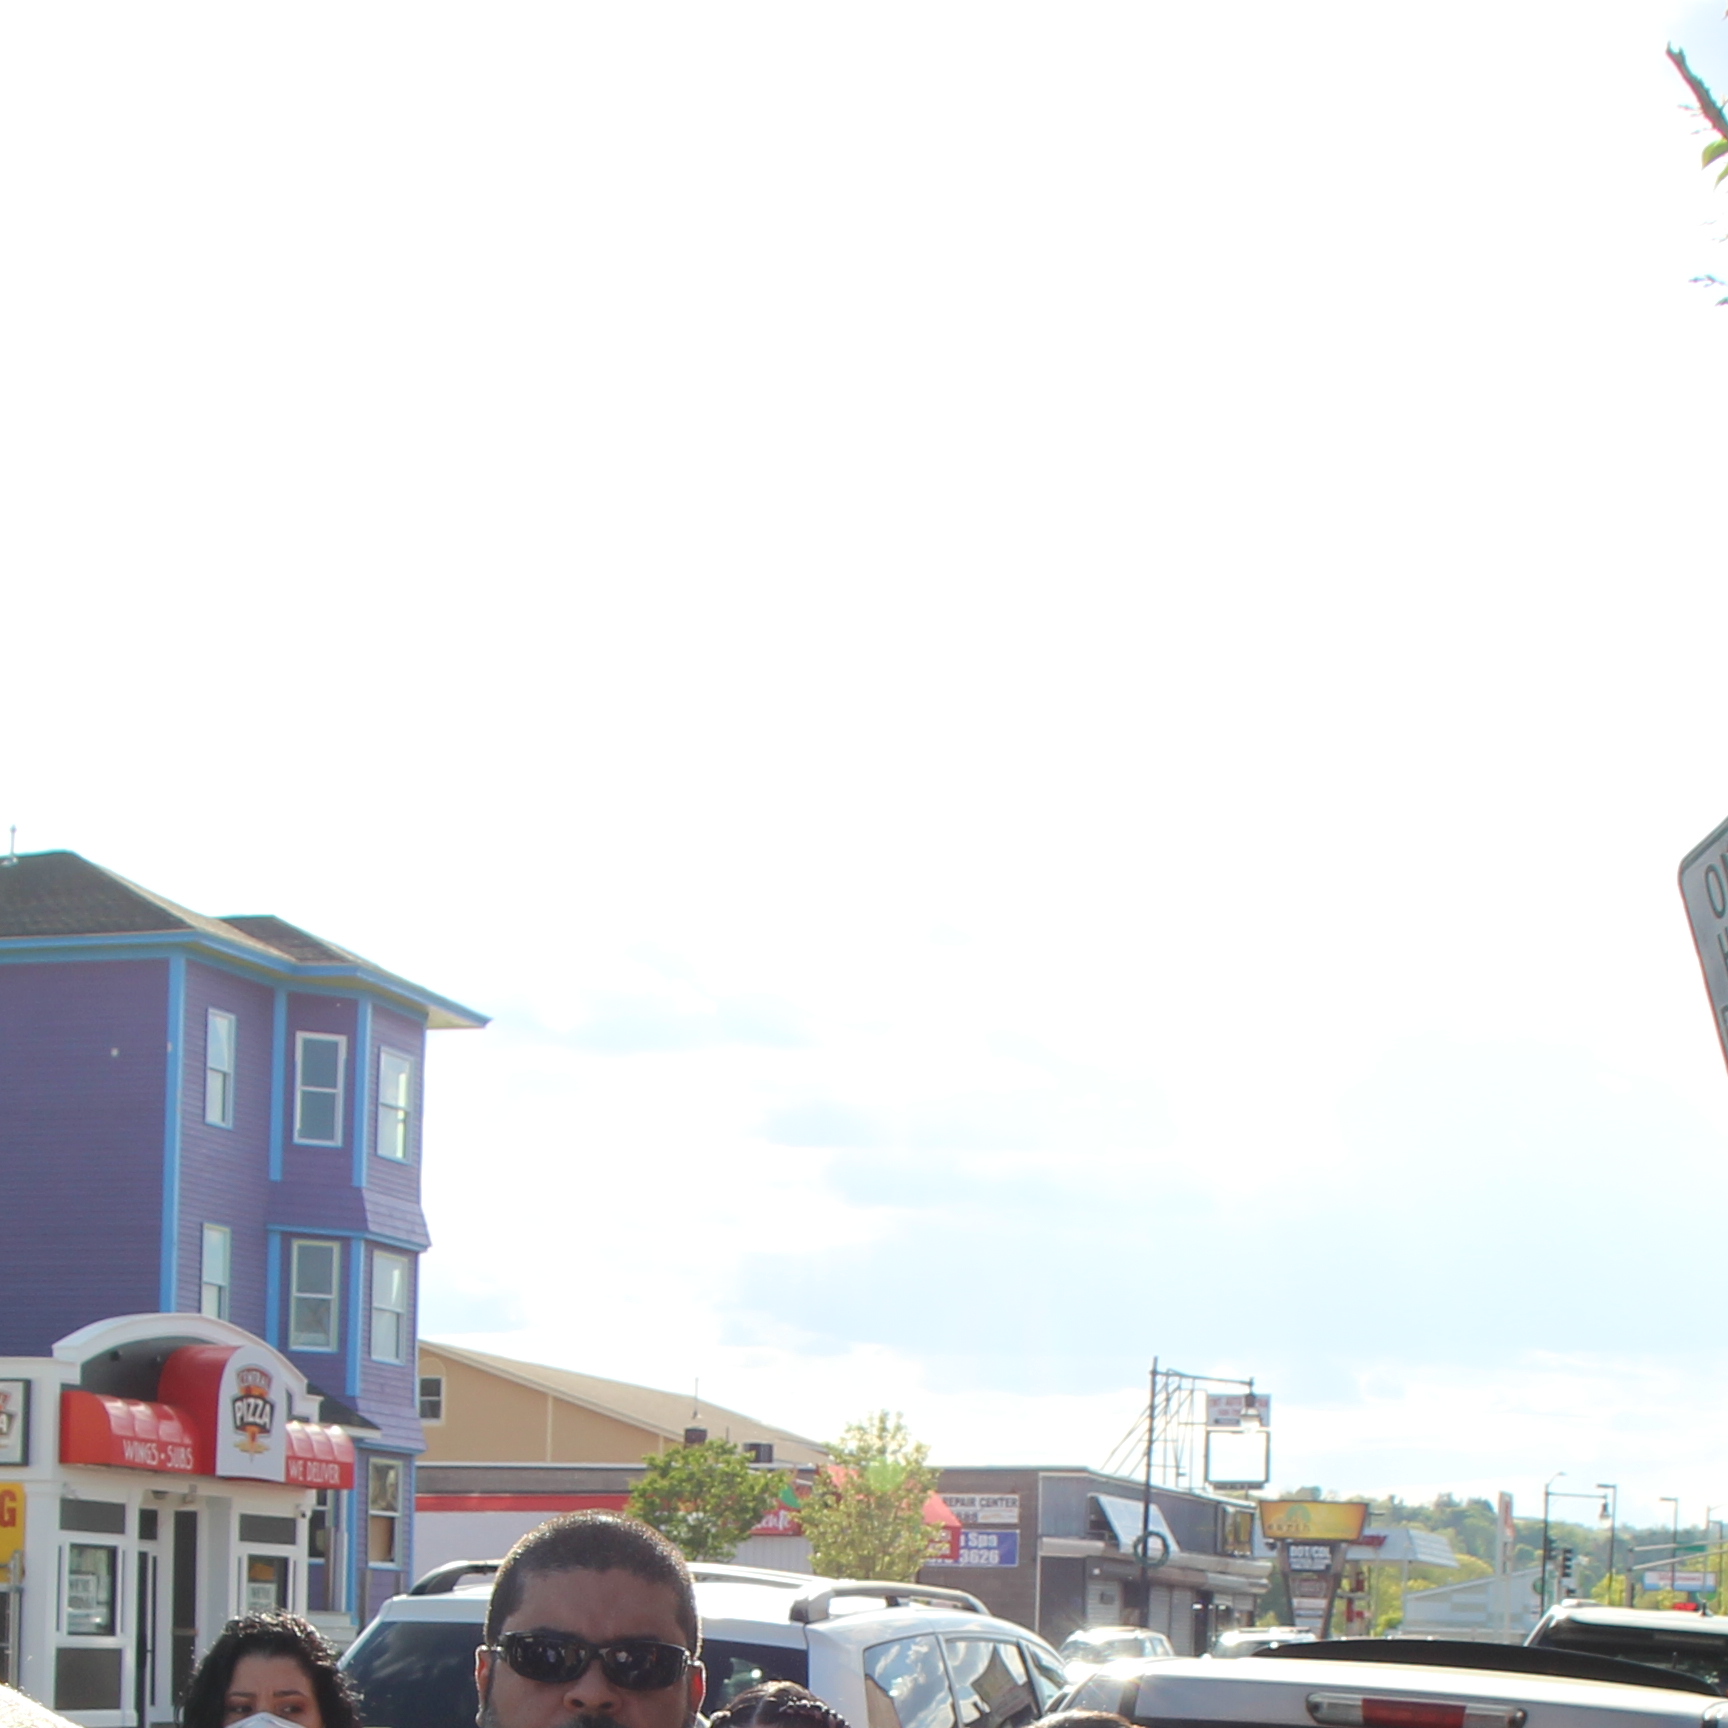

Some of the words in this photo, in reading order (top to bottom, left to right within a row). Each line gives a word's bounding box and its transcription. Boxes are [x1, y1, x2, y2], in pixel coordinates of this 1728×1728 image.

[235, 1399, 271, 1427] PIZZA
[123, 1439, 157, 1466] WINGS
[166, 1444, 194, 1470] SUBS
[288, 1458, 303, 1480] WE
[306, 1461, 340, 1484] DELIVER
